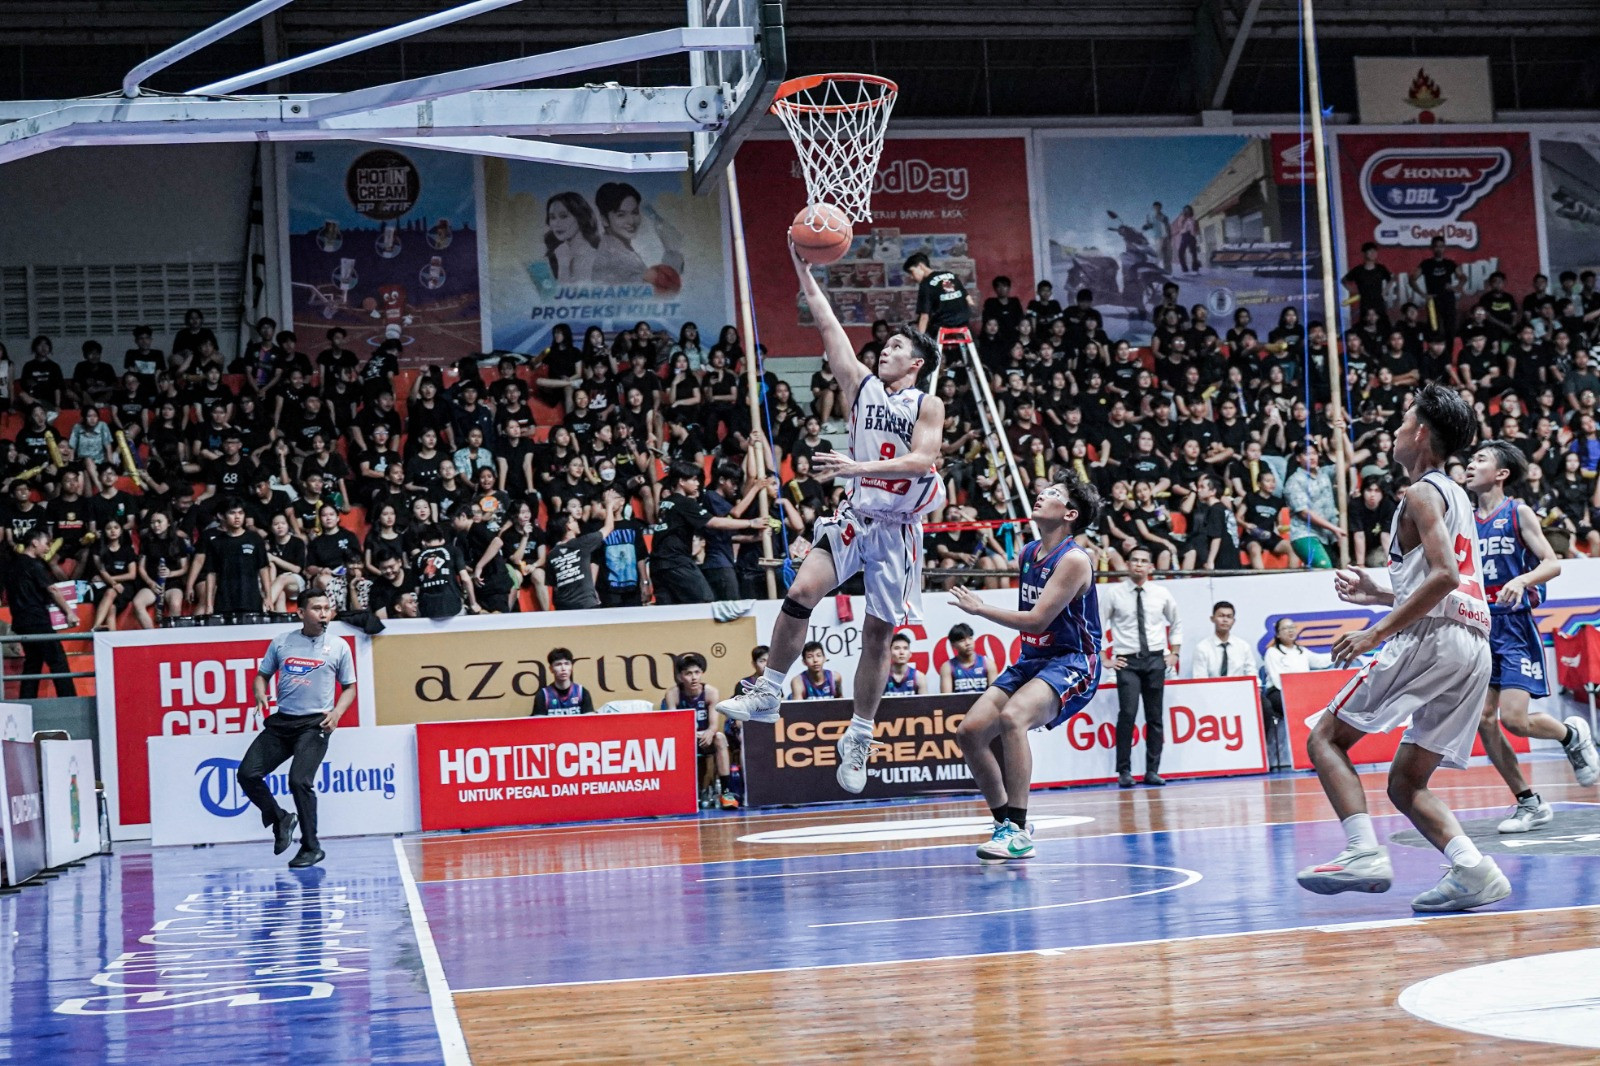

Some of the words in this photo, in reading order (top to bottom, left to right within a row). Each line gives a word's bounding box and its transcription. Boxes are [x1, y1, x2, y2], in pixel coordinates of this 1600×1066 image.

[905, 159, 969, 200] Day
[1403, 167, 1472, 179] HONDA
[358, 186, 407, 199] CREAM
[1405, 188, 1439, 205] DBL
[1411, 225, 1445, 239] Good
[1447, 224, 1472, 241] Day
[554, 285, 653, 300] JUARANYA
[531, 304, 621, 320] PROTEKSI
[626, 303, 681, 317] KULIT
[223, 474, 238, 484] 68
[1521, 657, 1543, 680] 24
[1169, 706, 1243, 751] Day
[555, 737, 676, 778] CREAM
[776, 745, 837, 769] ICE
[869, 740, 965, 763] REAM
[317, 761, 395, 799] Jateng
[867, 768, 881, 777] By
[881, 766, 933, 783] ULTRA
[458, 788, 503, 802] UNTUK
[505, 785, 549, 800] PEGAL
[552, 783, 579, 797] DAN
[582, 778, 660, 795] PEMANASAN
